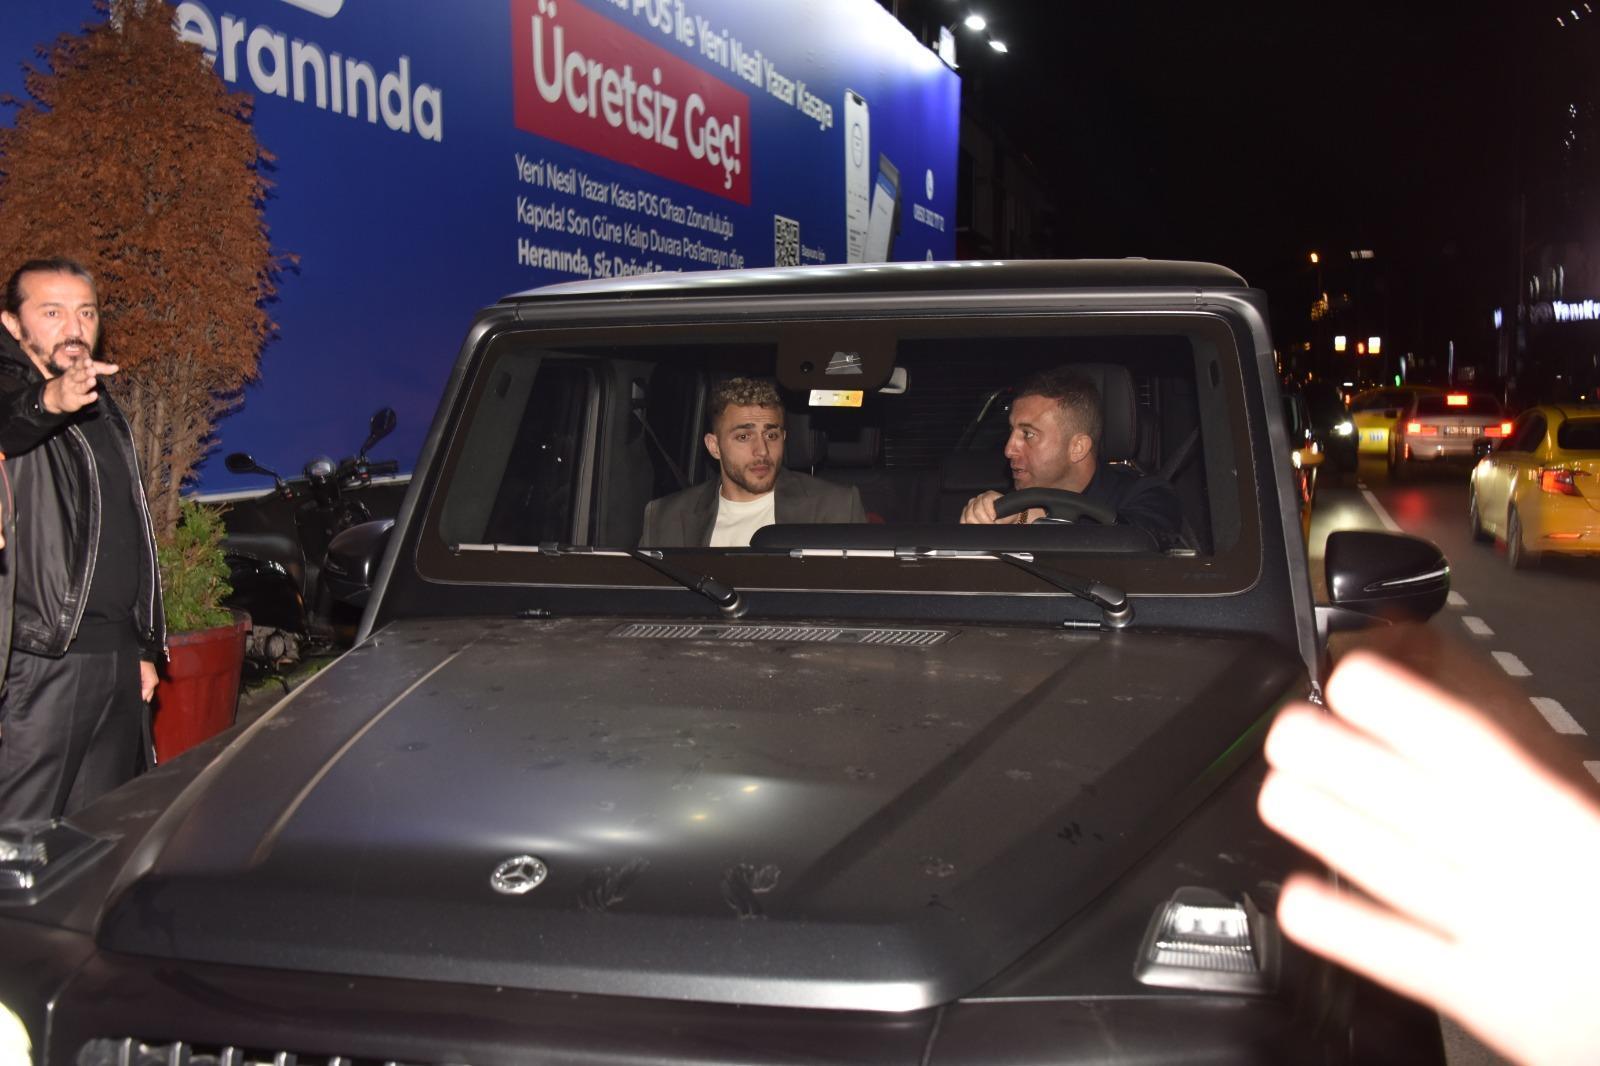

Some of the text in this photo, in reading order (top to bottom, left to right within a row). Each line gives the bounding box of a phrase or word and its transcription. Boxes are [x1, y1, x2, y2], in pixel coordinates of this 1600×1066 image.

[110, 0, 443, 143] eranında
[695, 15, 729, 68] Yeni
[730, 37, 763, 88] Nesil
[531, 0, 741, 190] Ücretsiz Geç!
[515, 152, 545, 187] Yeni
[546, 161, 577, 196] Nesil
[578, 171, 610, 204] Yazar
[611, 182, 637, 211] Kasa
[637, 189, 659, 217] POS
[516, 195, 566, 233] Kapıda!
[567, 208, 591, 237] Son
[592, 215, 623, 244] Güne
[623, 222, 649, 254] Kalıp
[650, 229, 682, 257] Duvara
[517, 238, 593, 280] Heranında,
[593, 251, 613, 278] Siz
